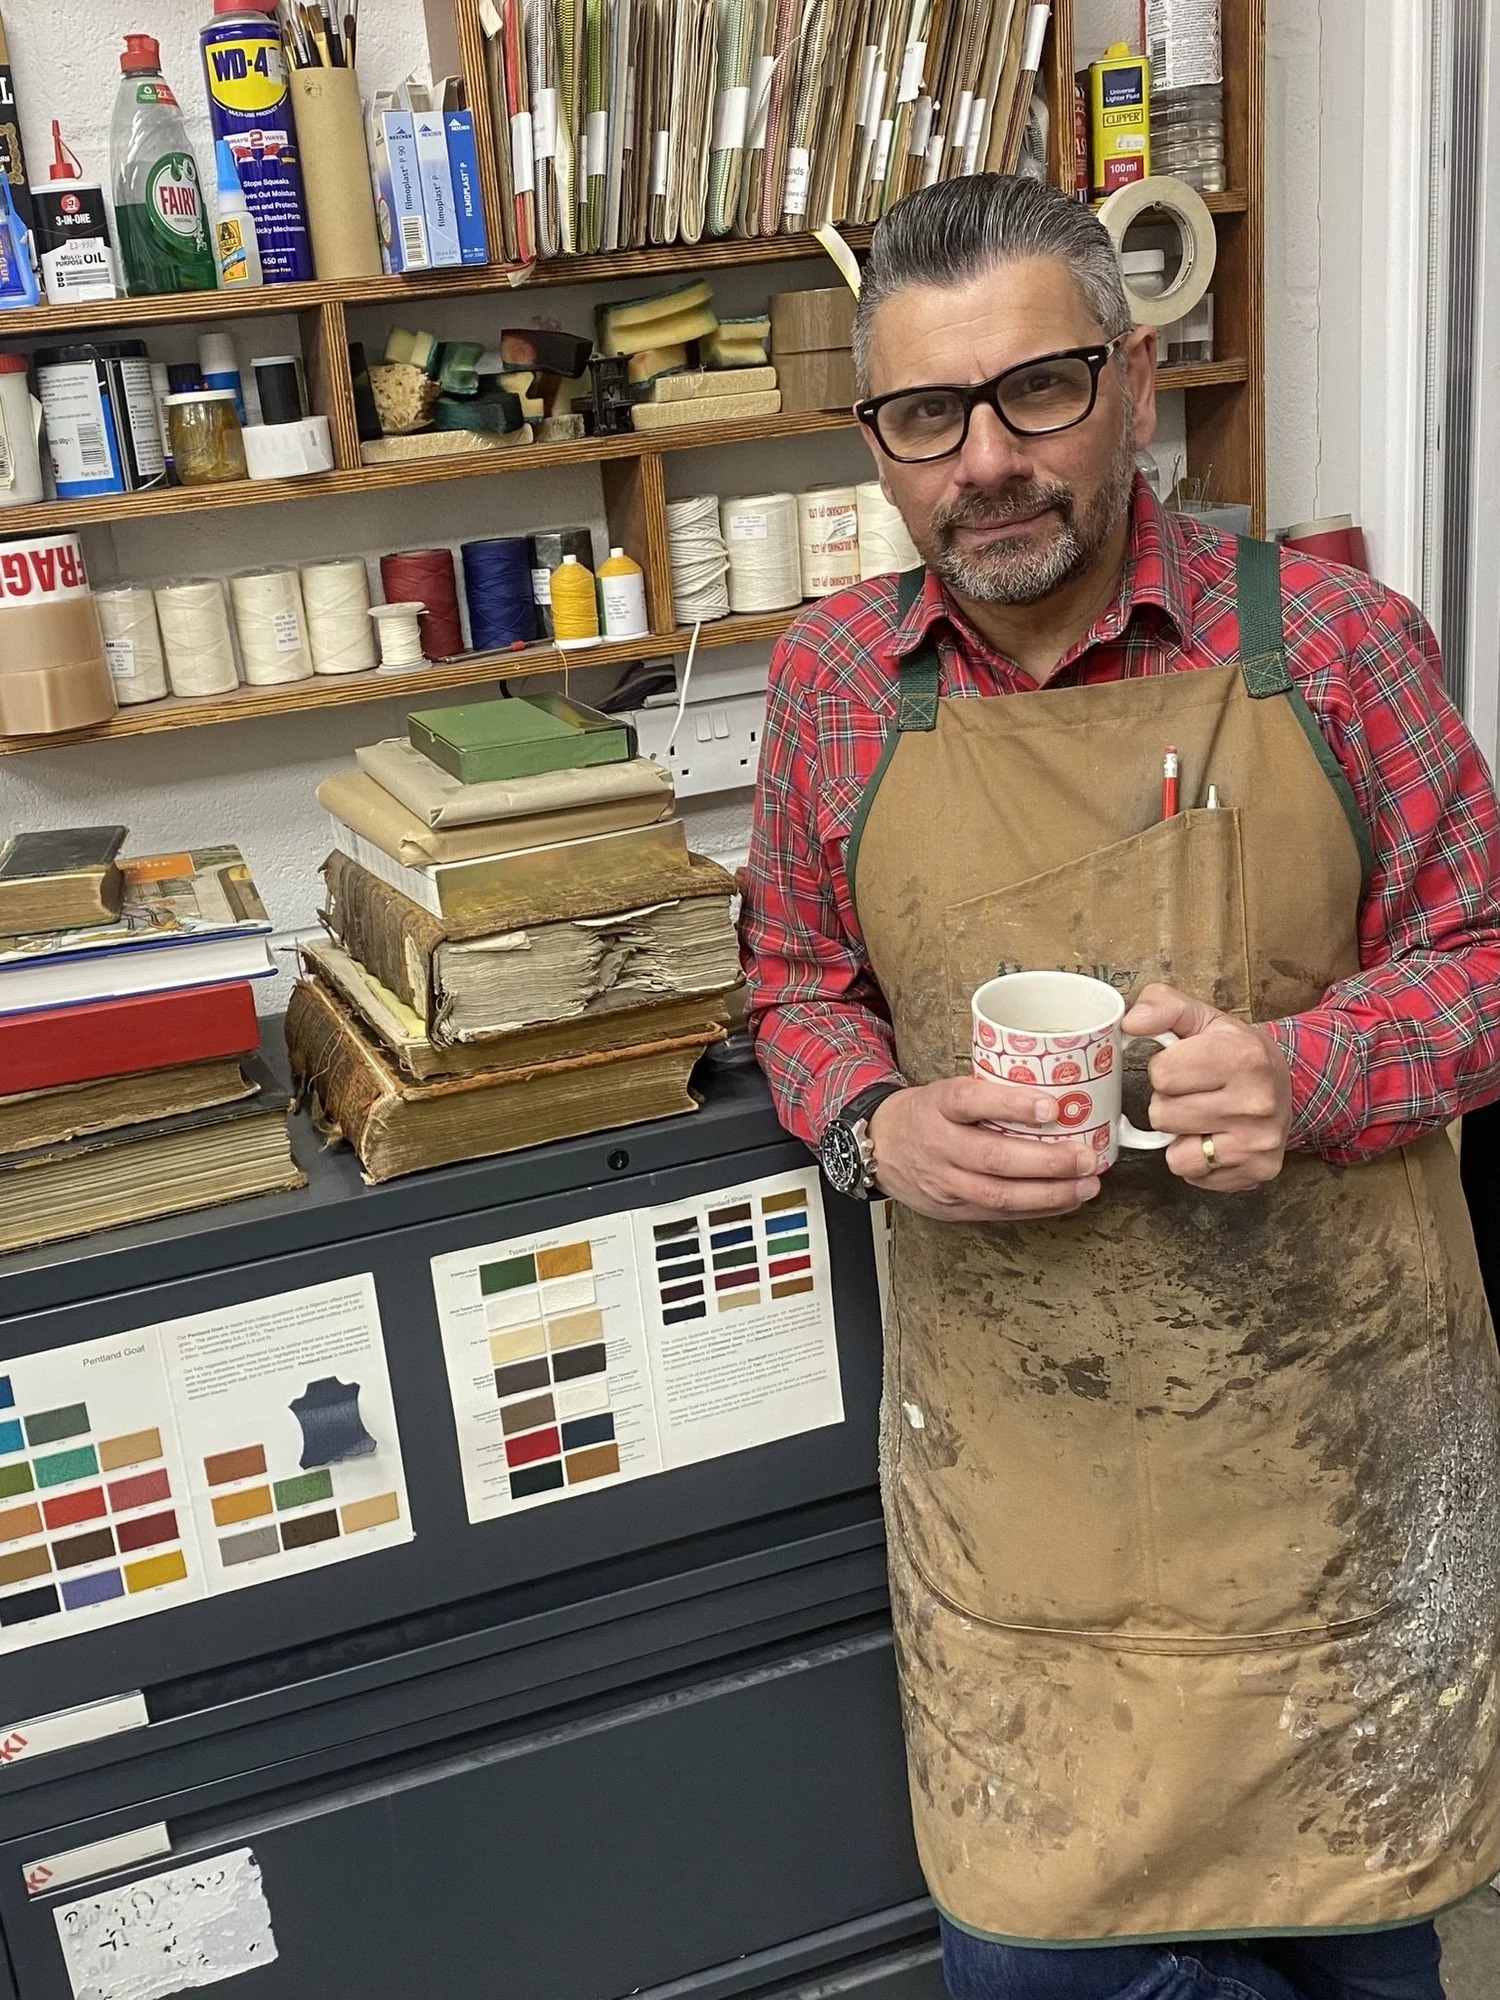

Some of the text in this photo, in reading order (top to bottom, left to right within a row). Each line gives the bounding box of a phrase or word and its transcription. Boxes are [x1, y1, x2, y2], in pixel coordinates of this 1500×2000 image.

[1109, 87, 1136, 96] Universal
[1126, 93, 1141, 101] Fluid
[1106, 113, 1141, 125] CLIPPER
[398, 145, 406, 156] 90
[243, 180, 262, 188] Stops
[158, 186, 197, 216] FAIRY
[55, 212, 92, 227] 3-IN-ONE
[84, 251, 106, 264] OIL
[262, 256, 287, 265] 450 ml
[0, 542, 87, 598] FRAG
[703, 1194, 752, 1210] Standard Shades
[508, 1247, 527, 1256] Types
[536, 1239, 559, 1250] Leather
[82, 1345, 146, 1367] Pentland Goat
